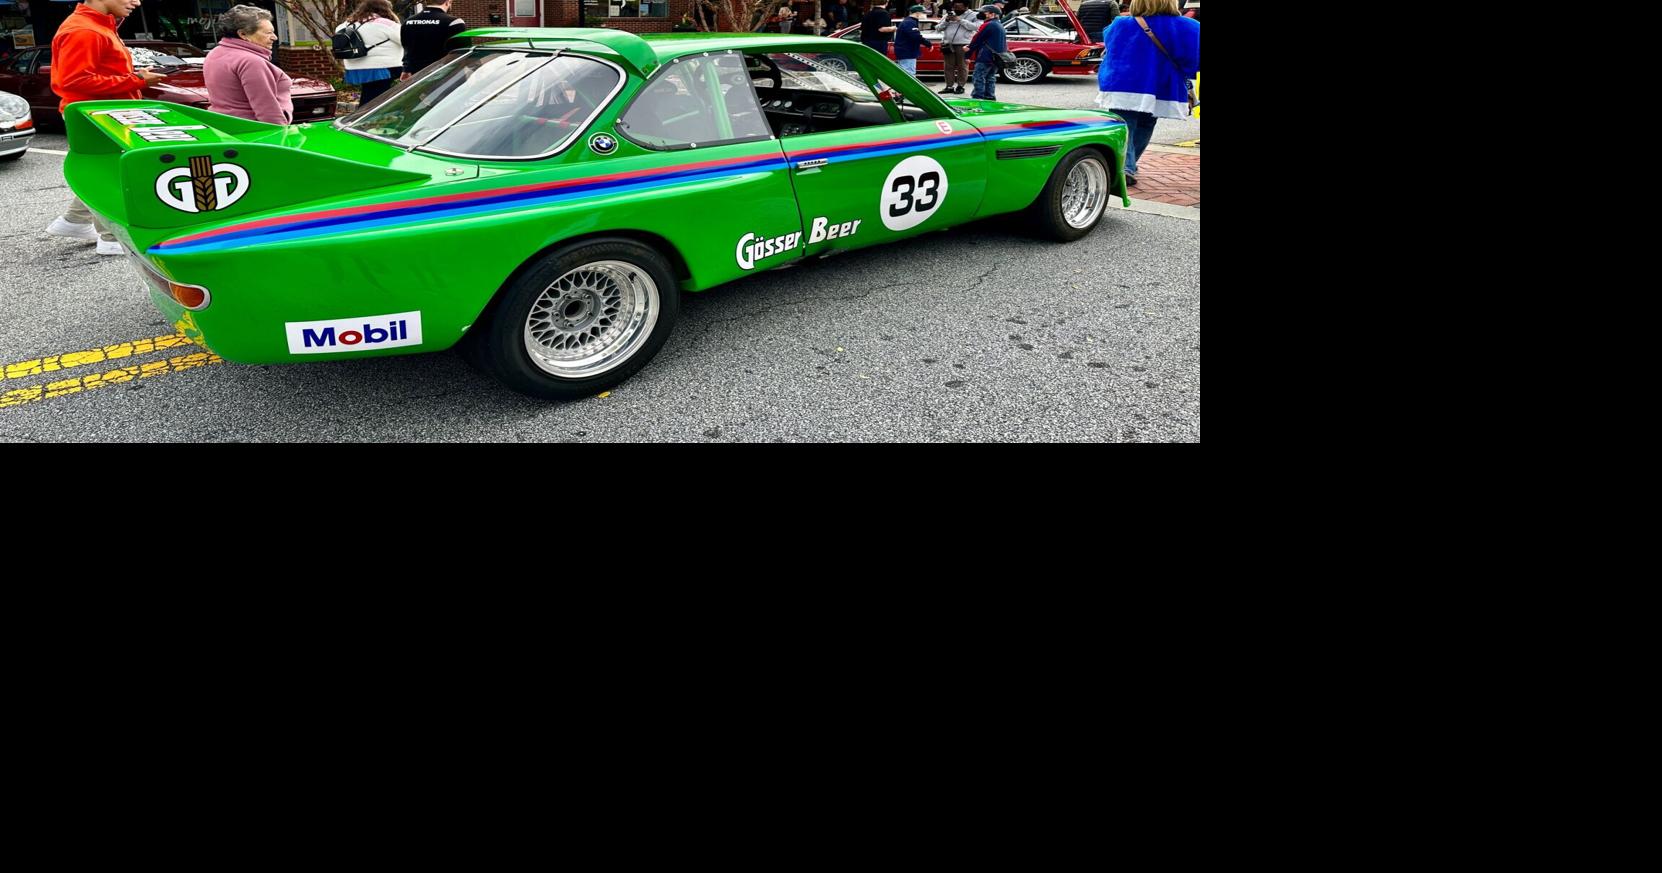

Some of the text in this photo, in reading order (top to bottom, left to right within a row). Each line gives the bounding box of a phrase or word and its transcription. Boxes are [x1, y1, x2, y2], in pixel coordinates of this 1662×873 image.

[889, 171, 940, 217] 33
[735, 215, 862, 270] Gösser Beer
[302, 320, 408, 348] Mobil
